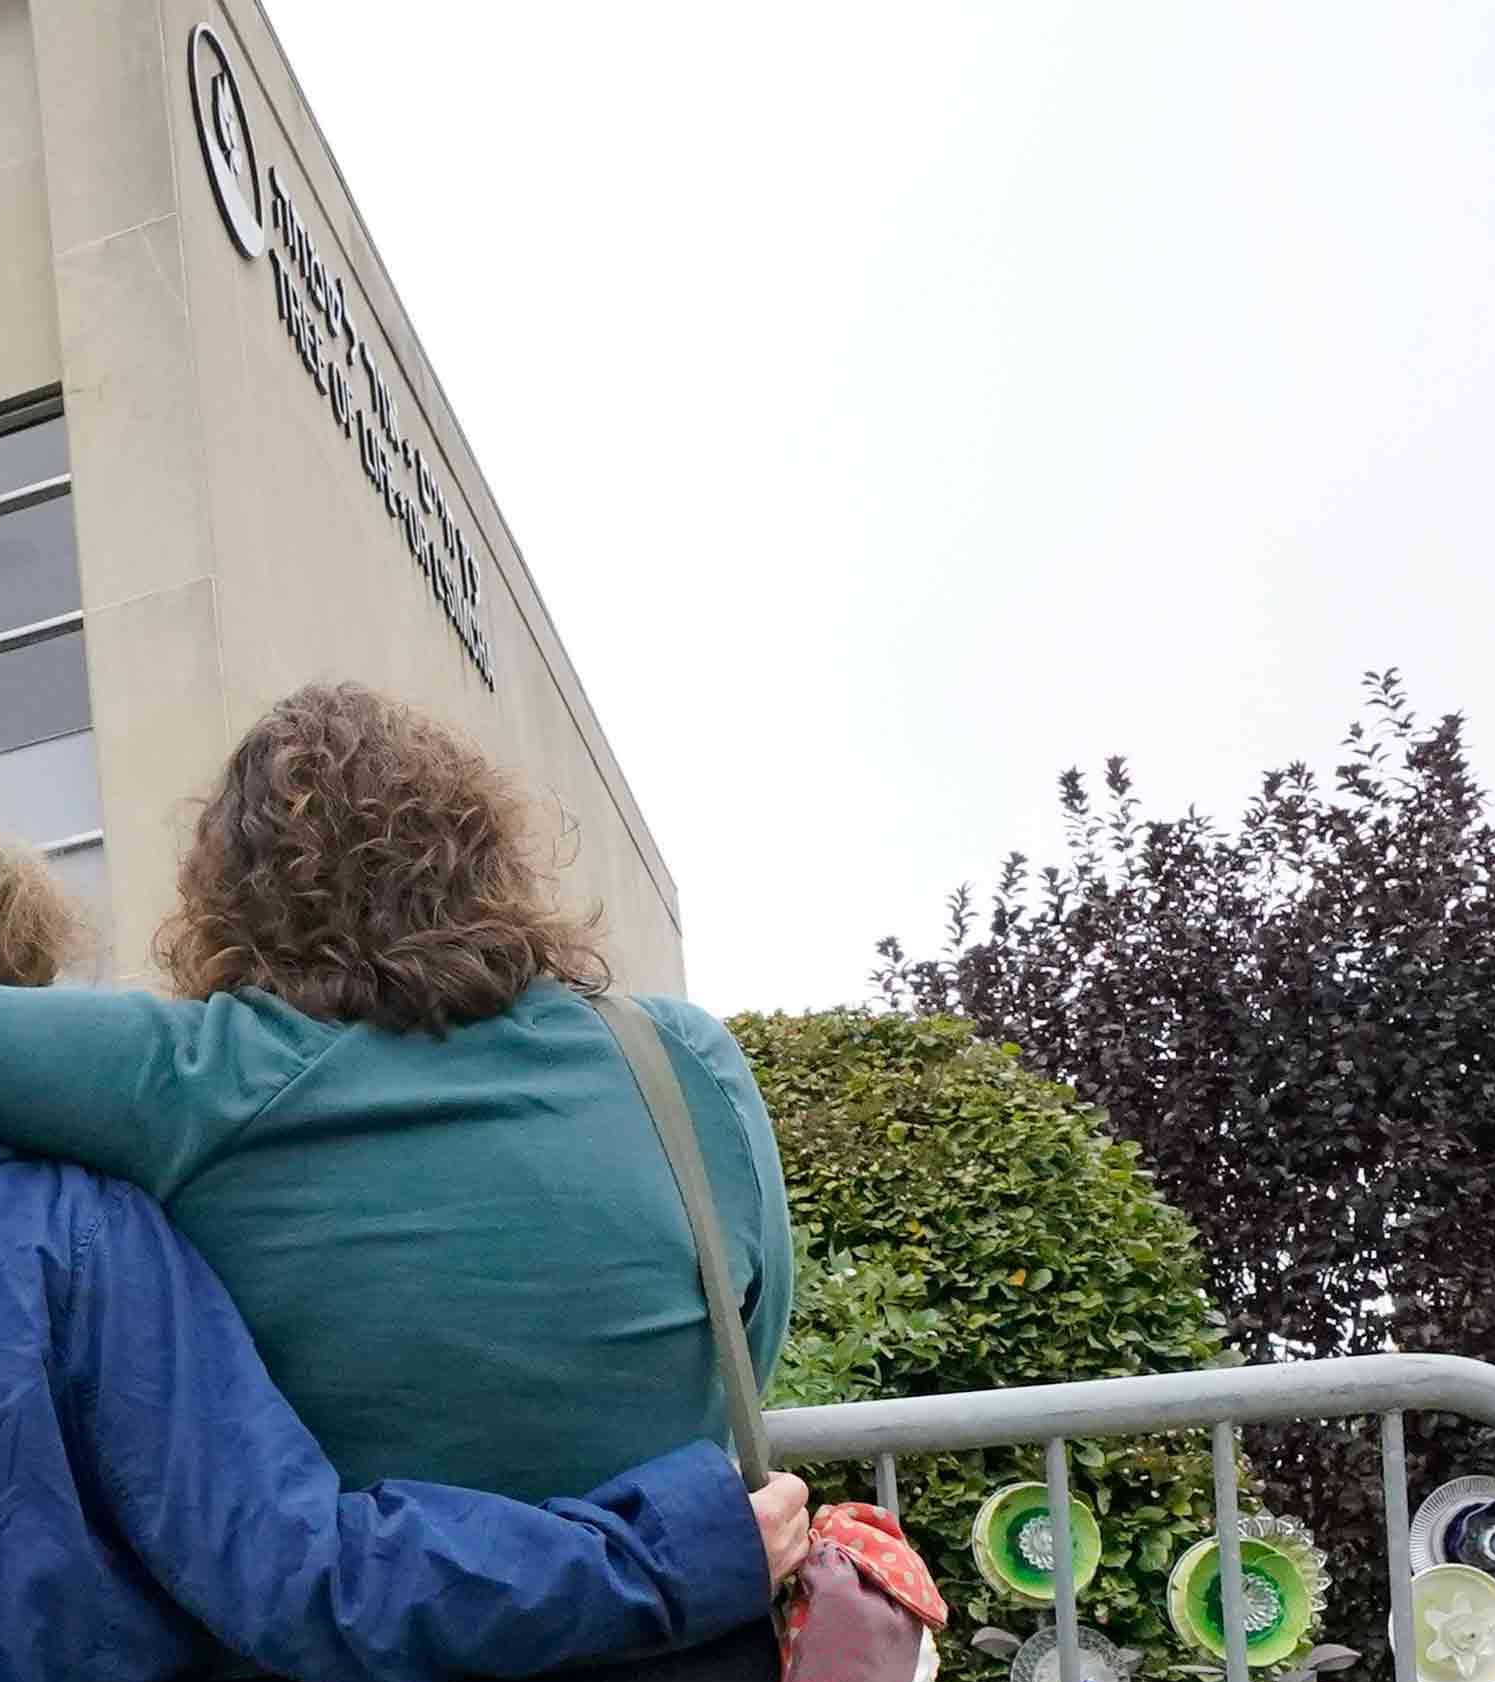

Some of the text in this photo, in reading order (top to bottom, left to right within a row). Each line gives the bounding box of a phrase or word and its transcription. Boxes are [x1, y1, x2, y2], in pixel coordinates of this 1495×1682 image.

[268, 247, 327, 396] TREE
[327, 361, 355, 439] OF
[355, 409, 396, 518] LIFE
